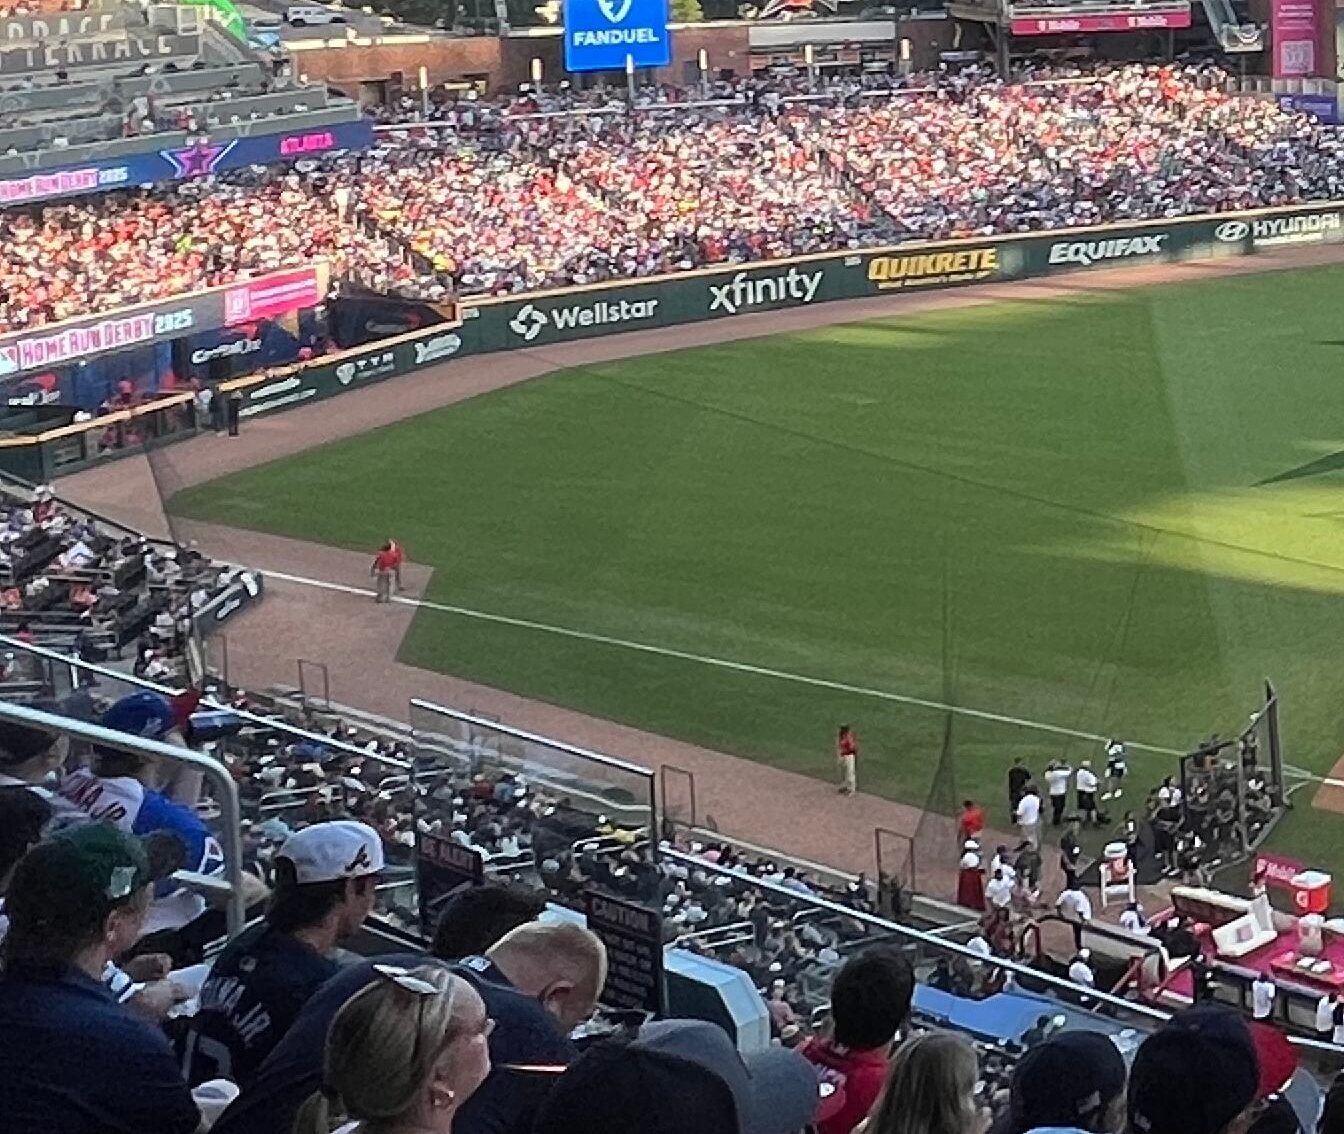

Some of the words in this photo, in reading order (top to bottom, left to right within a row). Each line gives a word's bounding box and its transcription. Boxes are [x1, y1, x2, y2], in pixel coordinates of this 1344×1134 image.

[573, 29, 659, 47] FANDUEL
[1253, 213, 1339, 237] HYUNDAI
[868, 248, 999, 281] QUIKRETE
[1049, 234, 1165, 265] EQUIFAX
[709, 269, 823, 314] xfinity
[551, 297, 658, 330] Wellstar
[22, 338, 67, 366] HOME
[69, 328, 101, 356] RUN
[103, 316, 153, 346] DERBY
[591, 898, 652, 931] CAUTION
